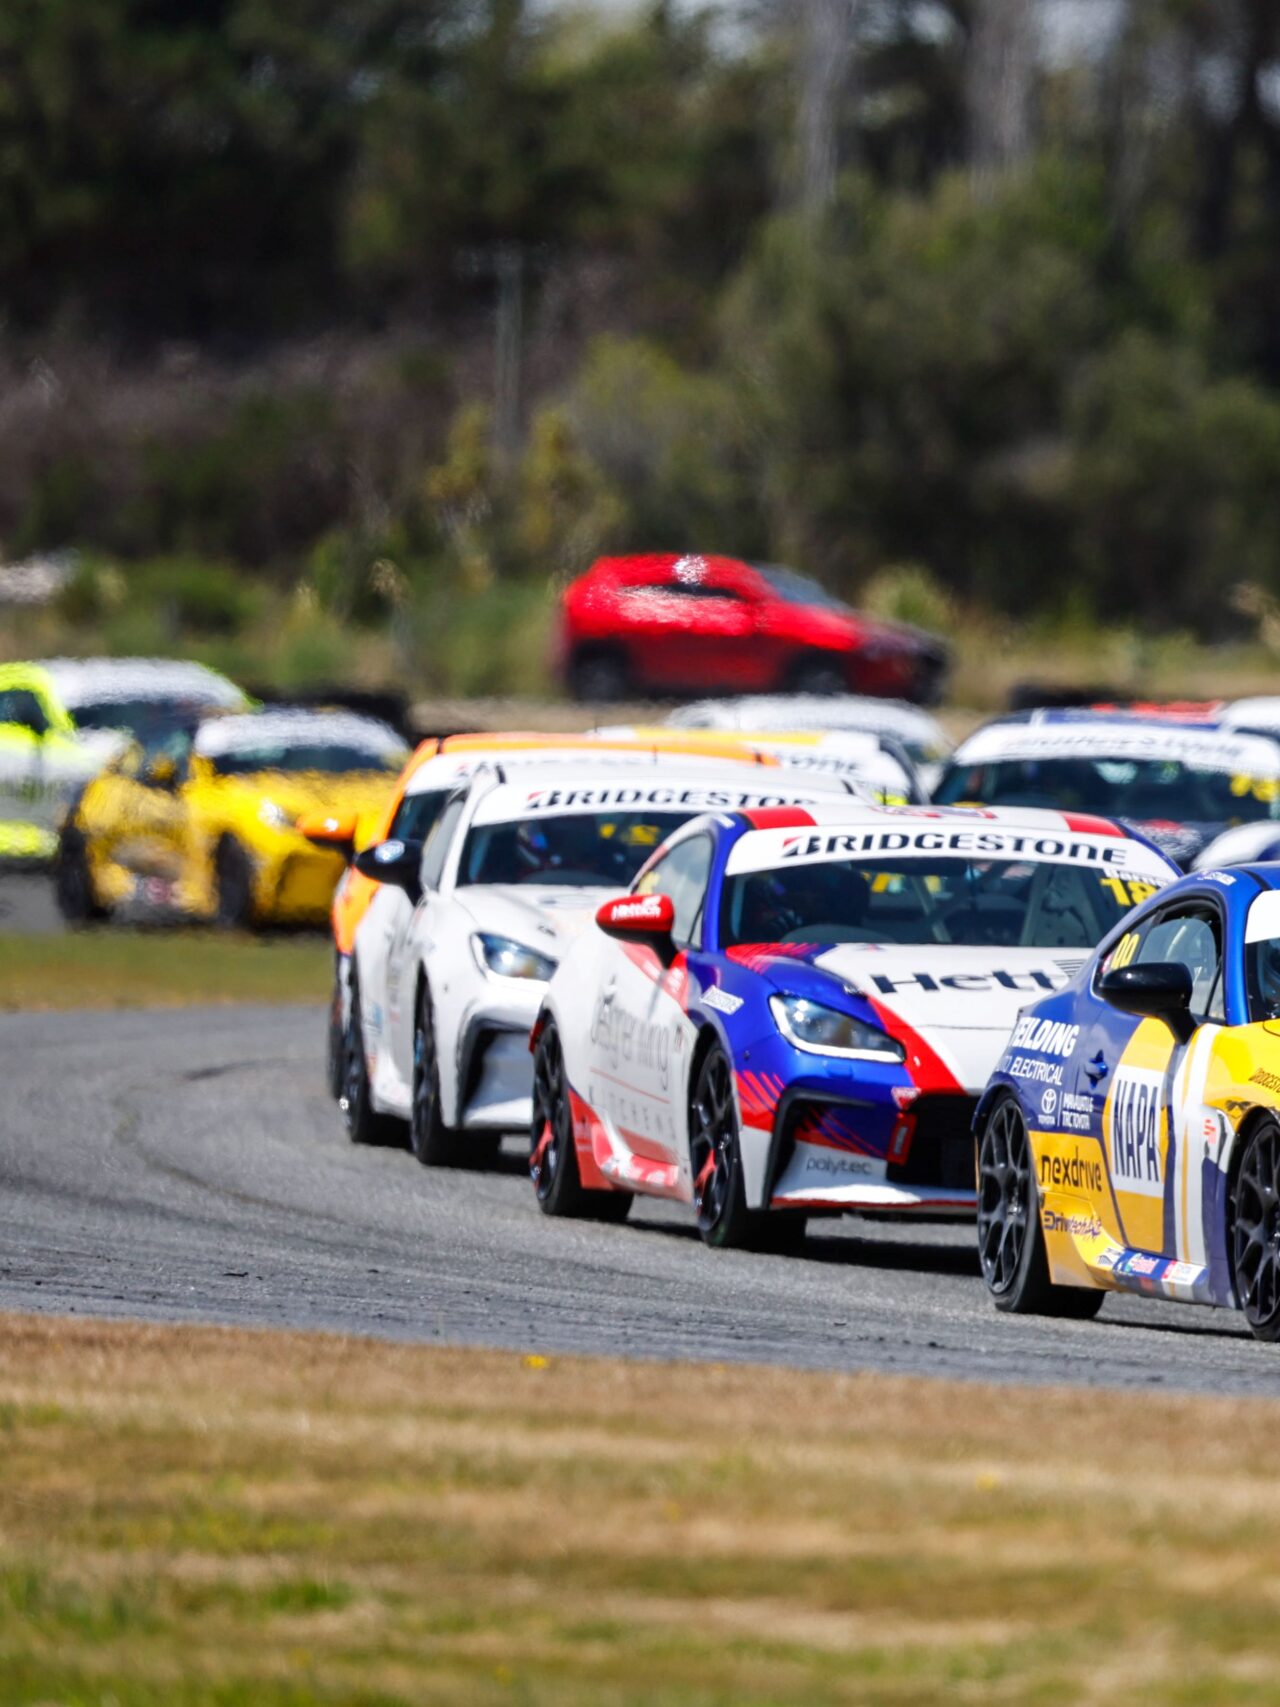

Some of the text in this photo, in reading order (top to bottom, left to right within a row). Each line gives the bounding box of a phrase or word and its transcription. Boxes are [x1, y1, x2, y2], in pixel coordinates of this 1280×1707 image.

[781, 832, 1128, 866] BRIDGESTONE
[1009, 1056, 1064, 1086] ELECTRICAL
[1112, 1078, 1160, 1183] NAPA
[806, 1156, 873, 1177] polytec
[1041, 1146, 1102, 1192] nexdrive
